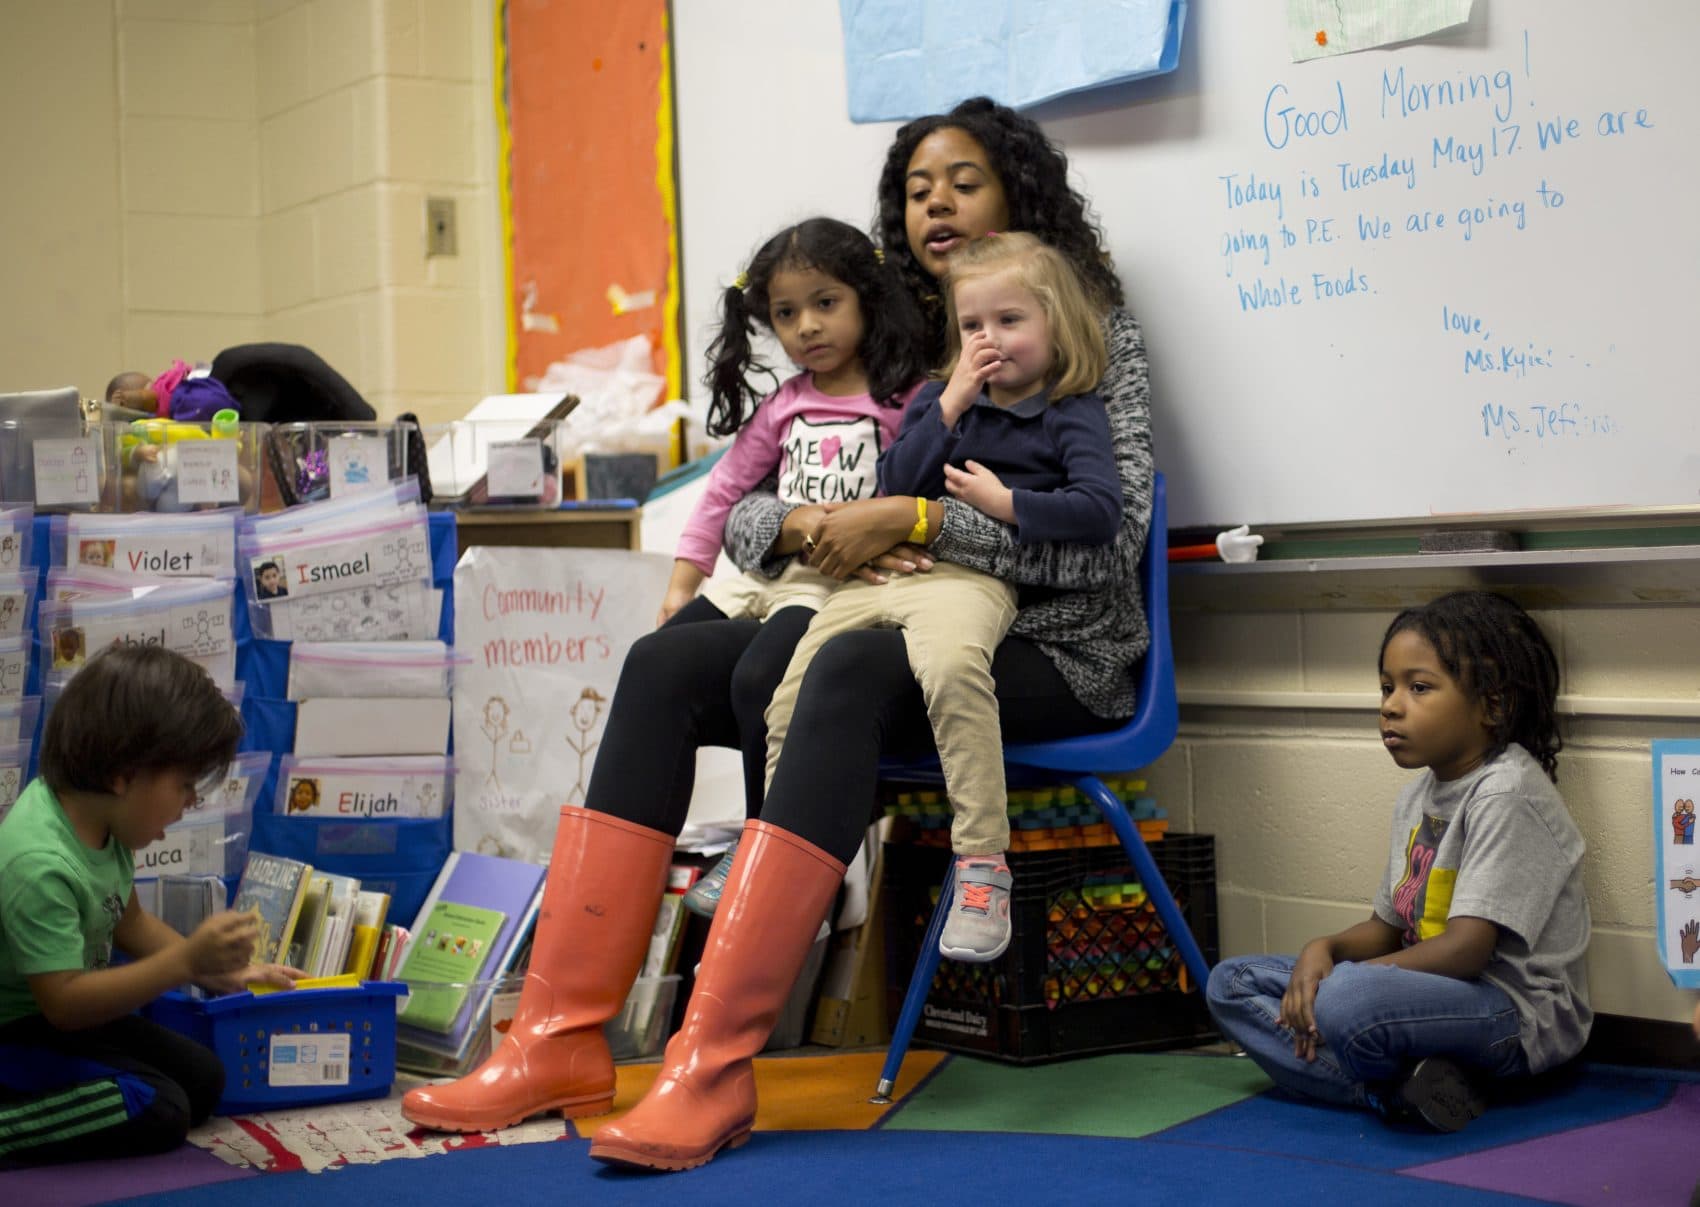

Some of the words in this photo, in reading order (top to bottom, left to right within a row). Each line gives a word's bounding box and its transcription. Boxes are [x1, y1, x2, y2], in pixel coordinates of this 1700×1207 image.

[1263, 82, 1349, 150] Good
[1381, 28, 1535, 122] Morning!
[1218, 173, 1285, 221] Today
[1300, 170, 1320, 198] is
[1338, 152, 1417, 190] Tuesday
[1432, 136, 1484, 176] May
[1537, 119, 1581, 151] We
[1598, 107, 1655, 137] are
[1222, 229, 1271, 278] going
[1279, 223, 1297, 249] to
[1306, 218, 1341, 244] P.E.
[1358, 215, 1392, 241] We
[1406, 212, 1445, 233] are
[1457, 198, 1526, 241] going
[1536, 180, 1565, 209] to
[1238, 278, 1303, 313] Whole
[1311, 266, 1378, 300] Foods.
[787, 468, 865, 502] MEOW
[127, 550, 194, 574] Violet
[296, 552, 371, 585] Ismael
[482, 580, 605, 622] Community
[483, 632, 611, 669] members
[1670, 767, 1686, 776] How
[338, 791, 399, 818] Elijah
